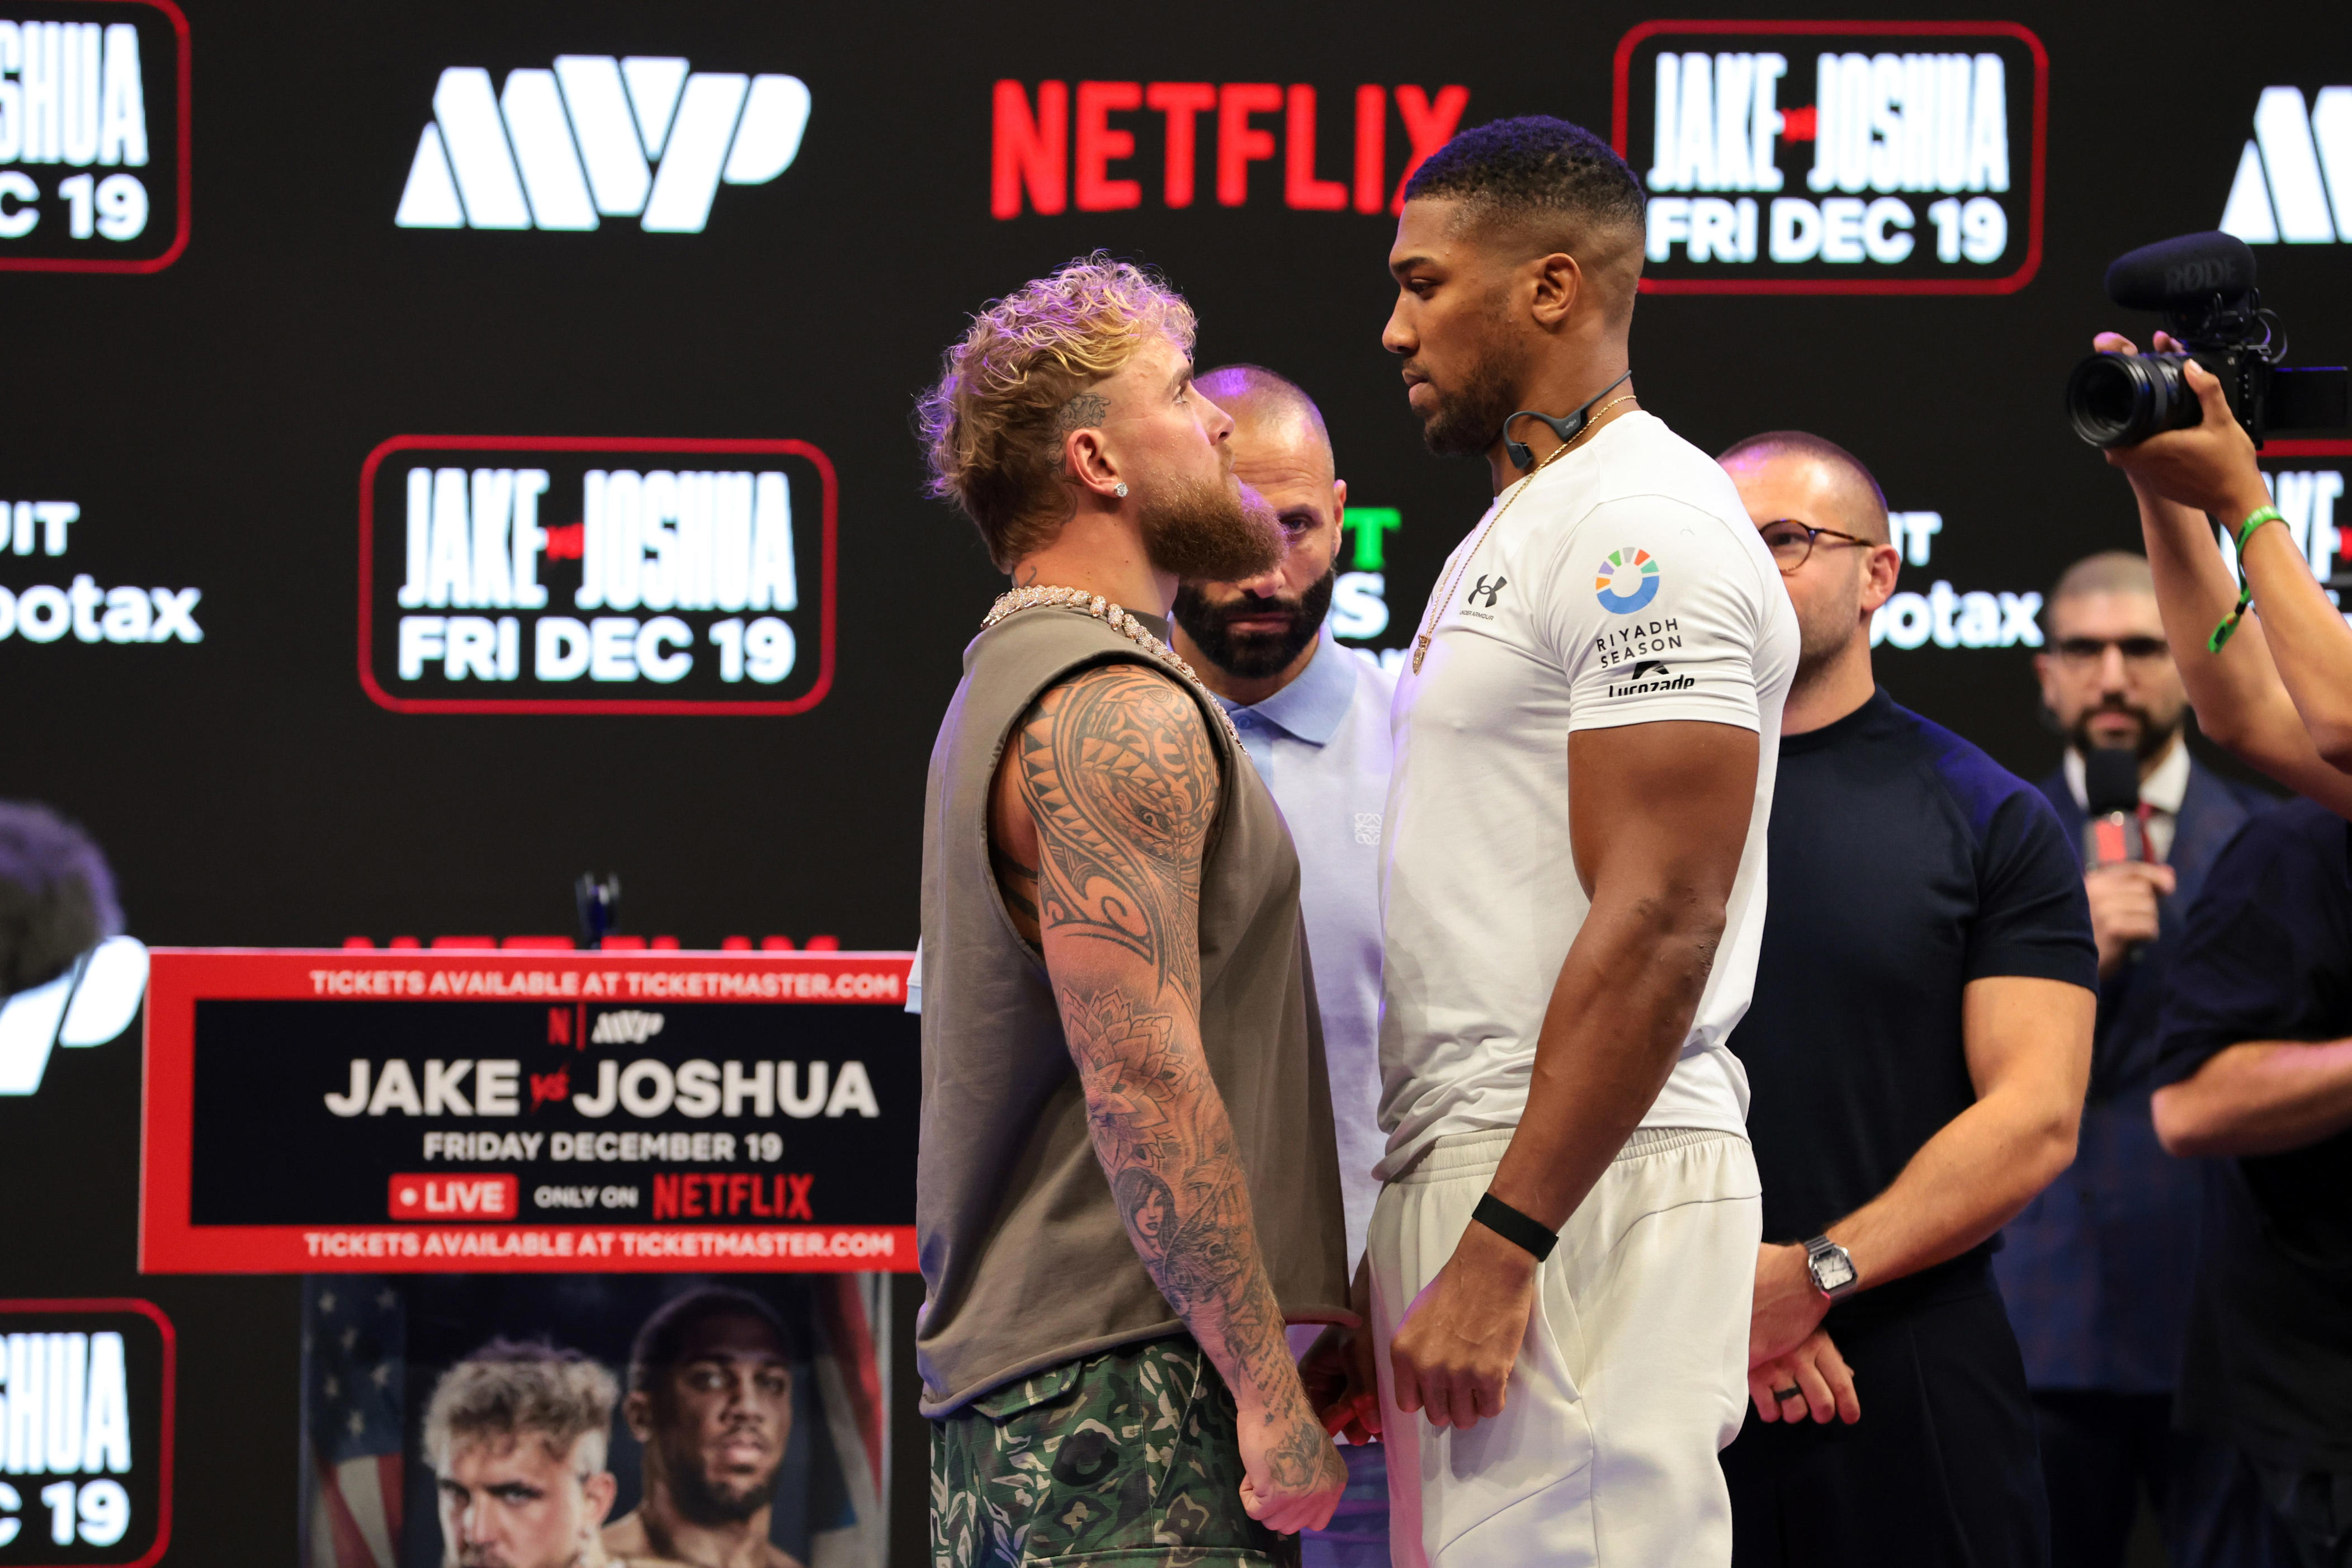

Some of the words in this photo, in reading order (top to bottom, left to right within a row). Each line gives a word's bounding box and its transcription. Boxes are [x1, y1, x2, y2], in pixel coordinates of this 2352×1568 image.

[395, 55, 810, 232] MVP
[991, 79, 1469, 219] NETFLIX
[1647, 53, 1787, 191] JAKE
[1807, 53, 2009, 192] JOSHUA
[59, 174, 148, 239] 19
[1647, 197, 1758, 262] FRI
[1769, 197, 1914, 262] DEC
[1929, 197, 2006, 262] 19
[398, 468, 549, 608] JAKE
[575, 470, 796, 610] JOSHUA
[1472, 611, 1494, 621] ARMOUR
[1597, 618, 1678, 651] RIYADH
[399, 616, 519, 680] FRI
[535, 616, 693, 681] DEC
[709, 617, 795, 682] 19
[1601, 635, 1682, 668] SEASON
[310, 970, 426, 995] TICKETS
[428, 971, 579, 996] AVAILABLE
[582, 972, 621, 996] AT
[625, 972, 899, 998] TICKETMASTER.COM
[592, 1010, 664, 1043] MVP
[325, 1060, 519, 1116] JAKE
[573, 1059, 879, 1118] JOSHUA
[424, 1132, 543, 1160] FRIDAY
[551, 1132, 735, 1161] DECEMBER
[745, 1133, 782, 1161] 19
[425, 1182, 504, 1212] LIVE
[535, 1187, 598, 1208] ONLY
[601, 1186, 638, 1208] ON
[653, 1173, 813, 1220] NETFLIX
[304, 1232, 420, 1257] TICKETS
[423, 1232, 573, 1256] AVAILABLE
[577, 1232, 615, 1256] AT
[619, 1232, 894, 1257] TICKETMASTER.COM
[0, 1332, 130, 1473] HUA
[41, 1479, 129, 1545] 19
